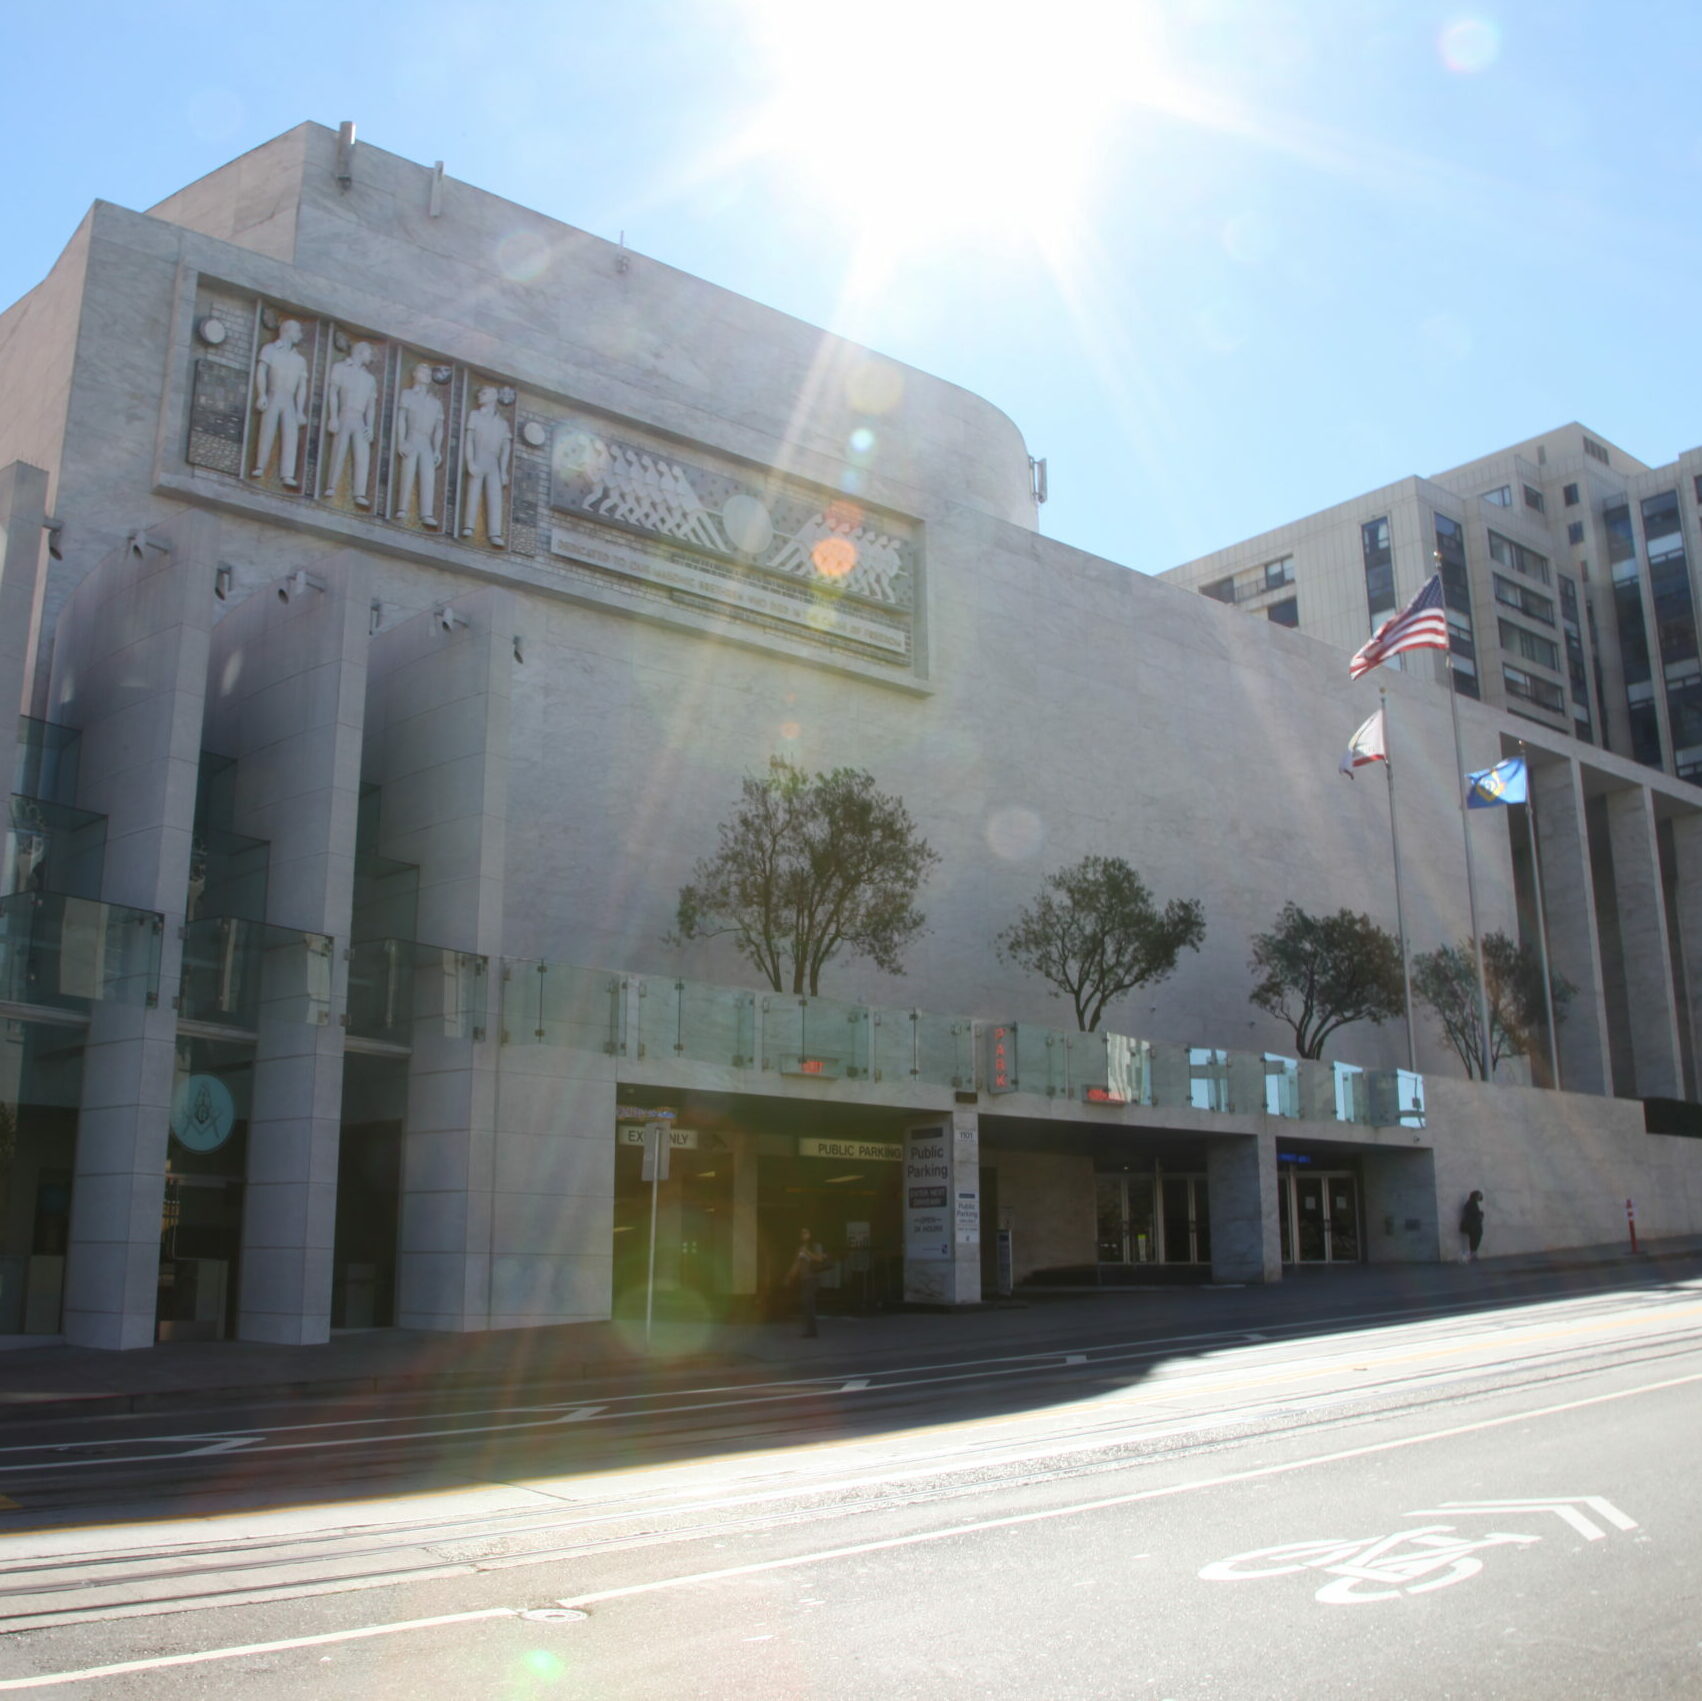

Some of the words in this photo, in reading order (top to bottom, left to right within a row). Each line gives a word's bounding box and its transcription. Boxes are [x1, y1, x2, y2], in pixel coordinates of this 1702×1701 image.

[994, 1027, 1007, 1088] PARK
[818, 1143, 855, 1156] PUBLIC
[859, 1146, 901, 1159] PARKING
[910, 1145, 944, 1159] Public
[908, 1164, 948, 1179] Parking
[957, 1210, 978, 1219] Parking
